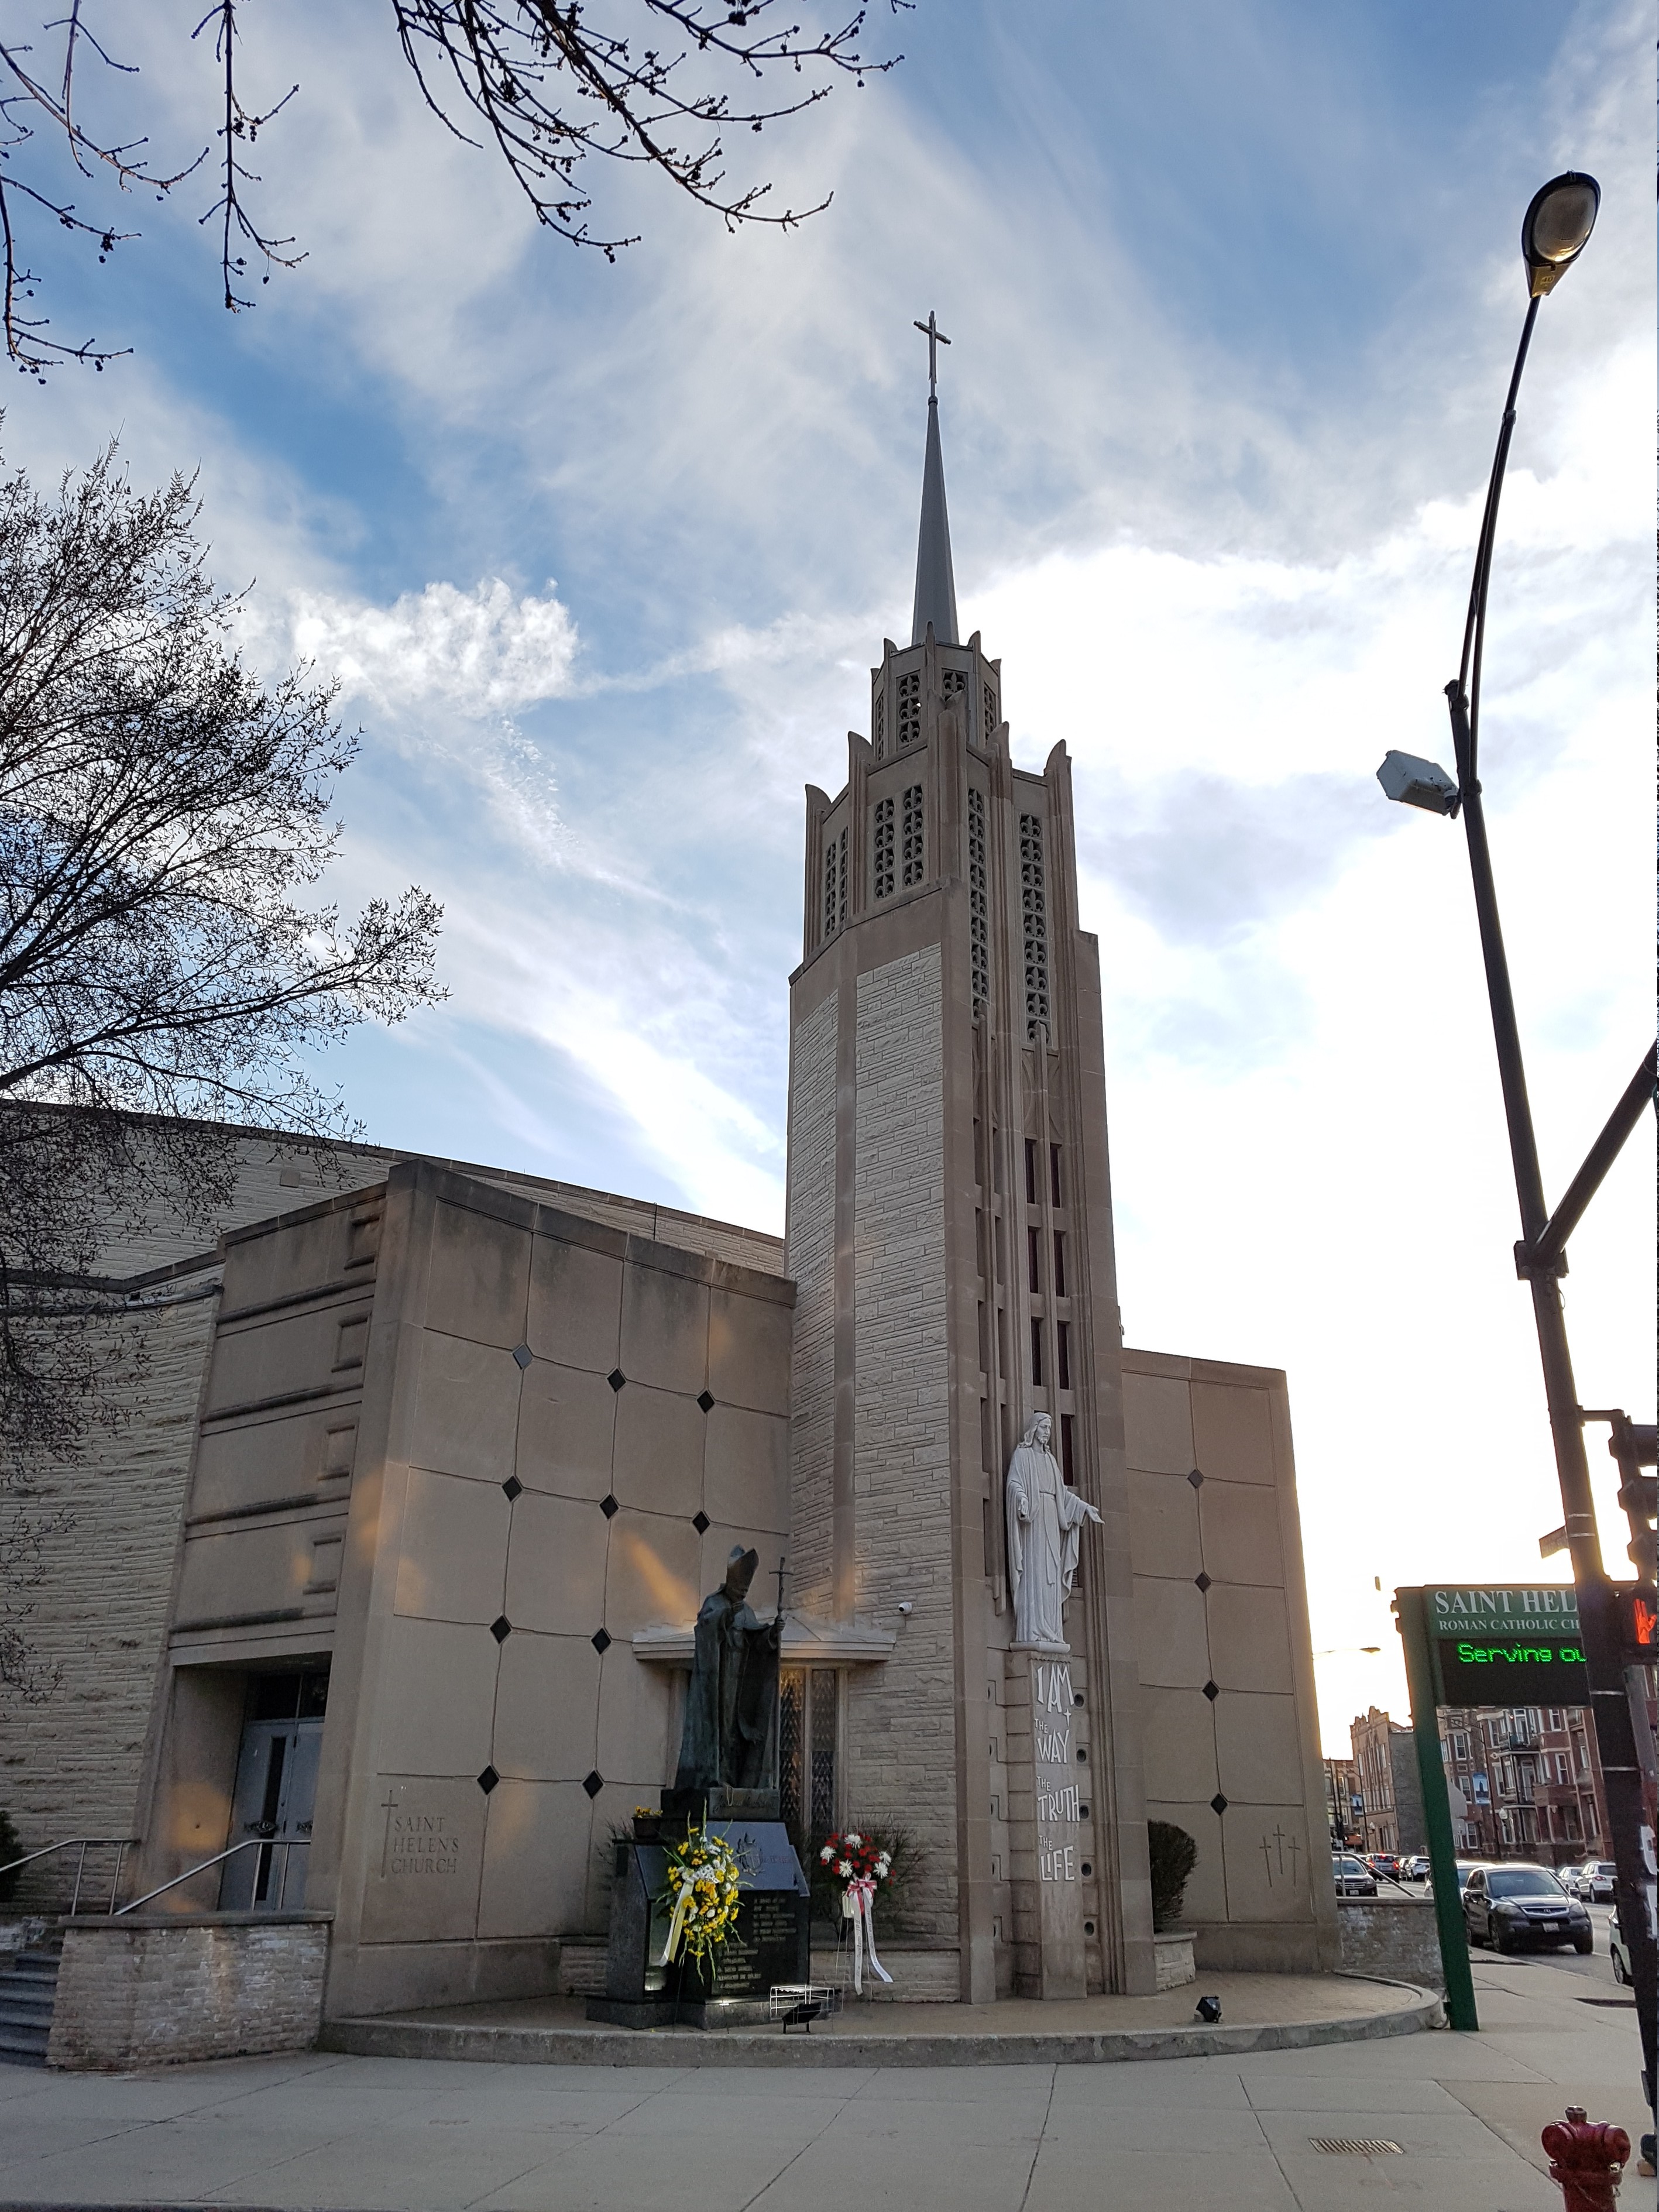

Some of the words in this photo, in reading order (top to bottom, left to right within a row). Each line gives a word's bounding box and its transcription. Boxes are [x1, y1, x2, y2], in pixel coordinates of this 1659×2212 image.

[1435, 1590, 1513, 1614] SAINT
[1439, 1620, 1487, 1630] ROMAN
[1490, 1619, 1557, 1630] CATHOLIC
[1457, 1643, 1552, 1663] Serving
[1038, 1666, 1044, 1704] I
[1047, 1664, 1074, 1713] AM
[1035, 1718, 1048, 1734] THE
[1038, 1729, 1070, 1764] WAY
[1036, 1776, 1051, 1791] THE
[1038, 1784, 1080, 1822] TRUTH
[394, 1816, 445, 1832] SAINT
[1039, 1835, 1053, 1850] THE
[391, 1859, 457, 1874] CHURCH
[1040, 1845, 1075, 1881] LIFE
